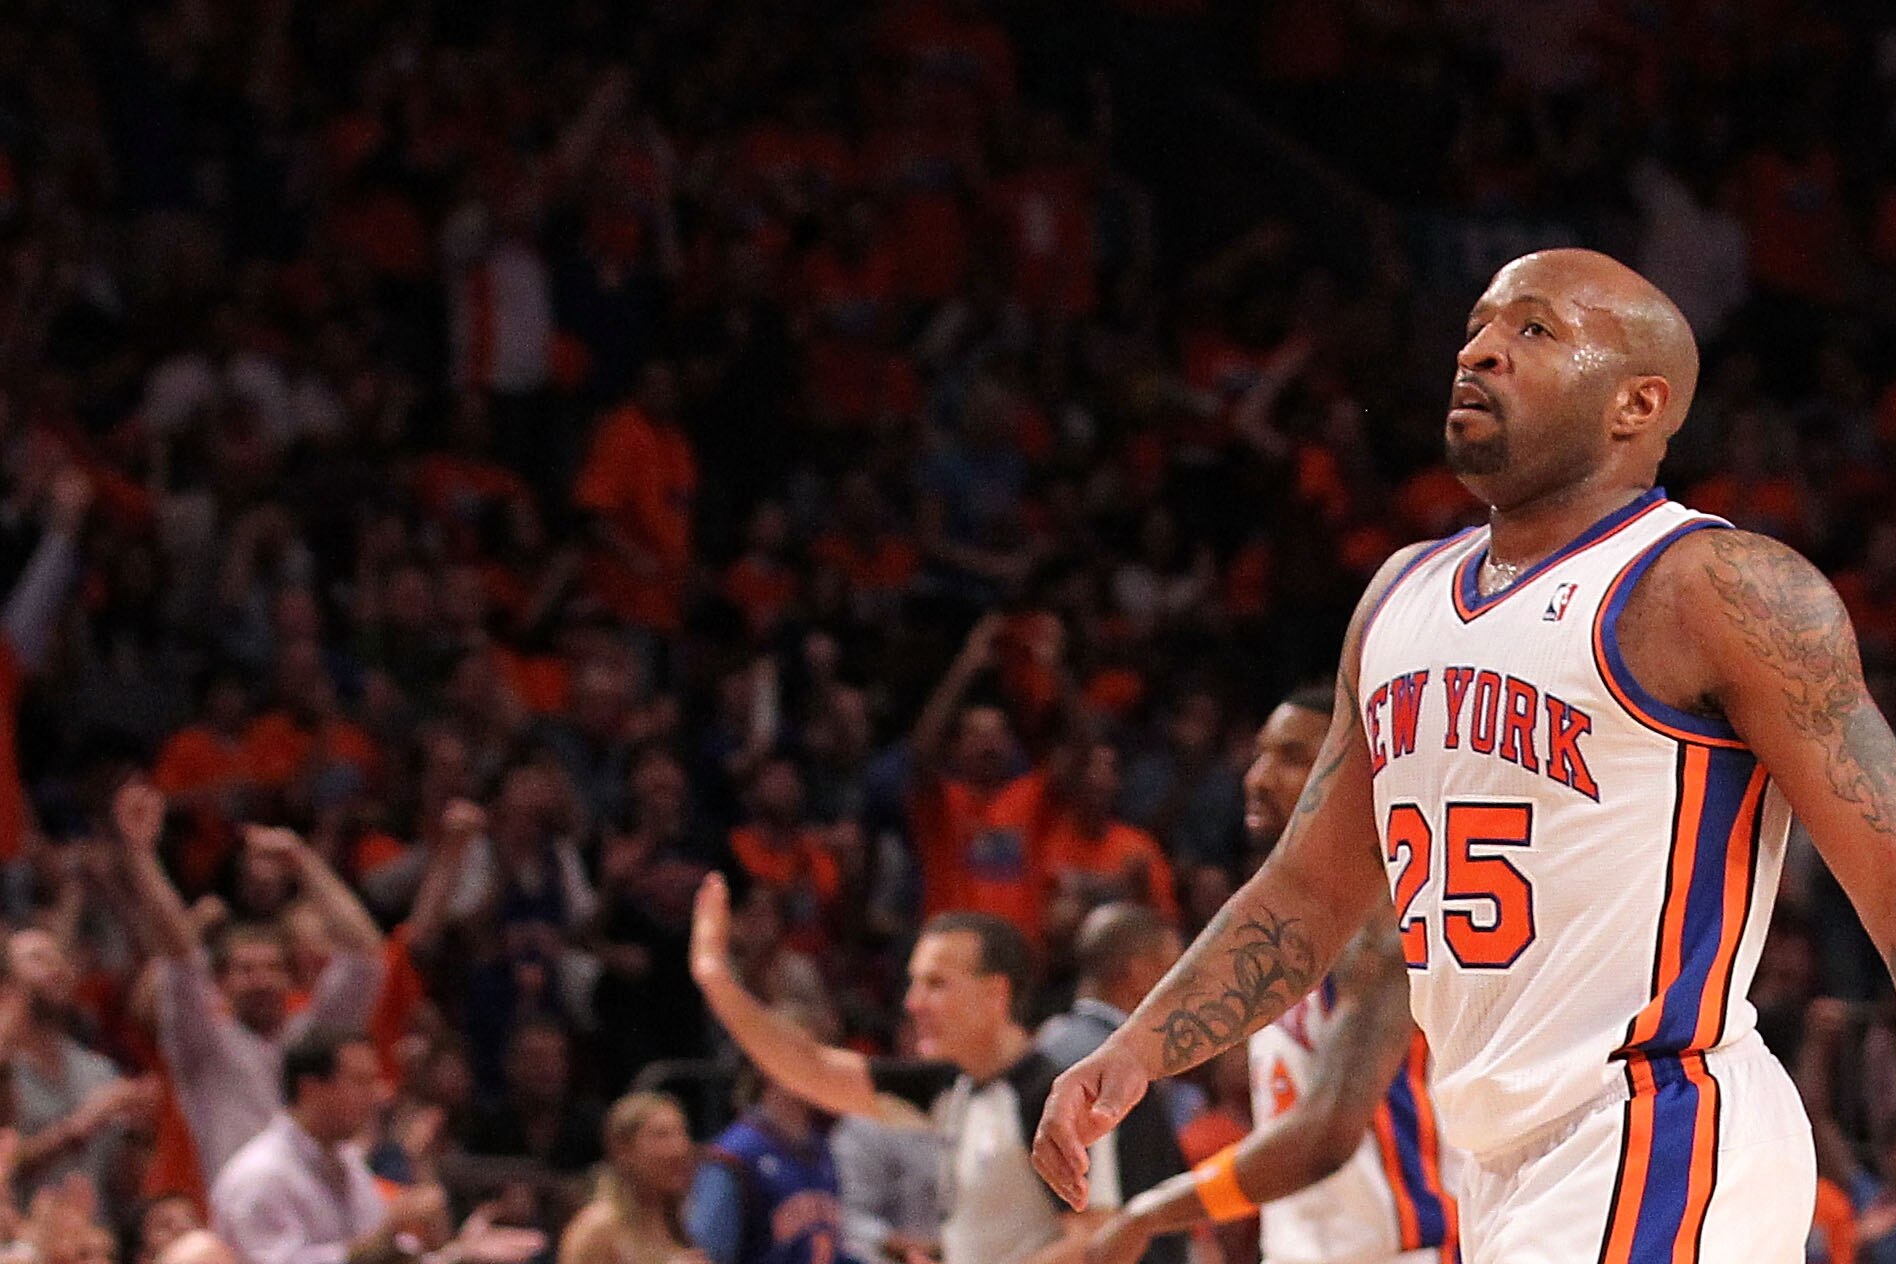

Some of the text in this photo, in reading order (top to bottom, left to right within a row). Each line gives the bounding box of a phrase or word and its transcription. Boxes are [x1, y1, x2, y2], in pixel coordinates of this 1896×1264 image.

[1366, 666, 1601, 804] EW YORK
[1386, 800, 1537, 970] 25
